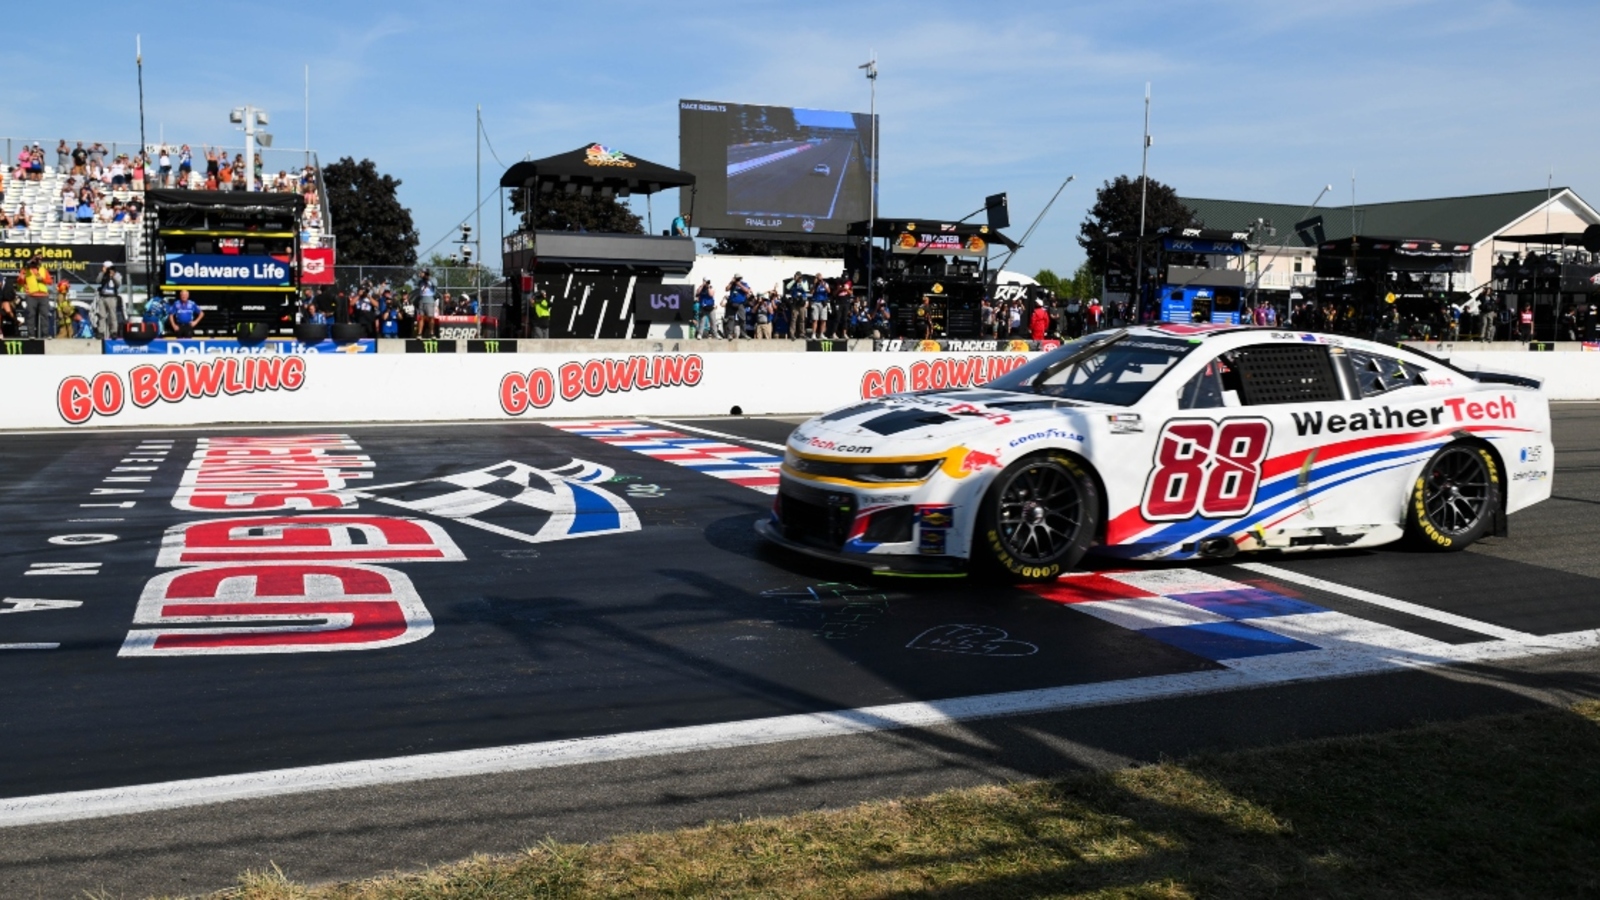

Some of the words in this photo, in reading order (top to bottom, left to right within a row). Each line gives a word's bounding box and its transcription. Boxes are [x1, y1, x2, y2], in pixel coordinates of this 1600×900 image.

[681, 102, 698, 110] RACE
[699, 103, 727, 113] RESULTS
[745, 217, 766, 227] FINAL
[767, 219, 782, 227] LAP
[14, 247, 31, 258] so
[34, 245, 72, 259] clean
[169, 261, 250, 279] Delaware
[253, 263, 285, 280] Life
[993, 285, 1028, 301] RFK
[948, 339, 998, 352] TRACKER
[57, 375, 125, 424] GO
[129, 355, 306, 408] BOWLING
[499, 367, 555, 416] GO
[559, 354, 704, 401] BOWLING
[860, 364, 905, 400] GO
[1291, 395, 1516, 437] WeatherTech
[1008, 427, 1086, 448] GOODYEAR
[171, 433, 377, 512] Watkins
[1141, 415, 1273, 523] 88
[117, 514, 469, 657] Glen
